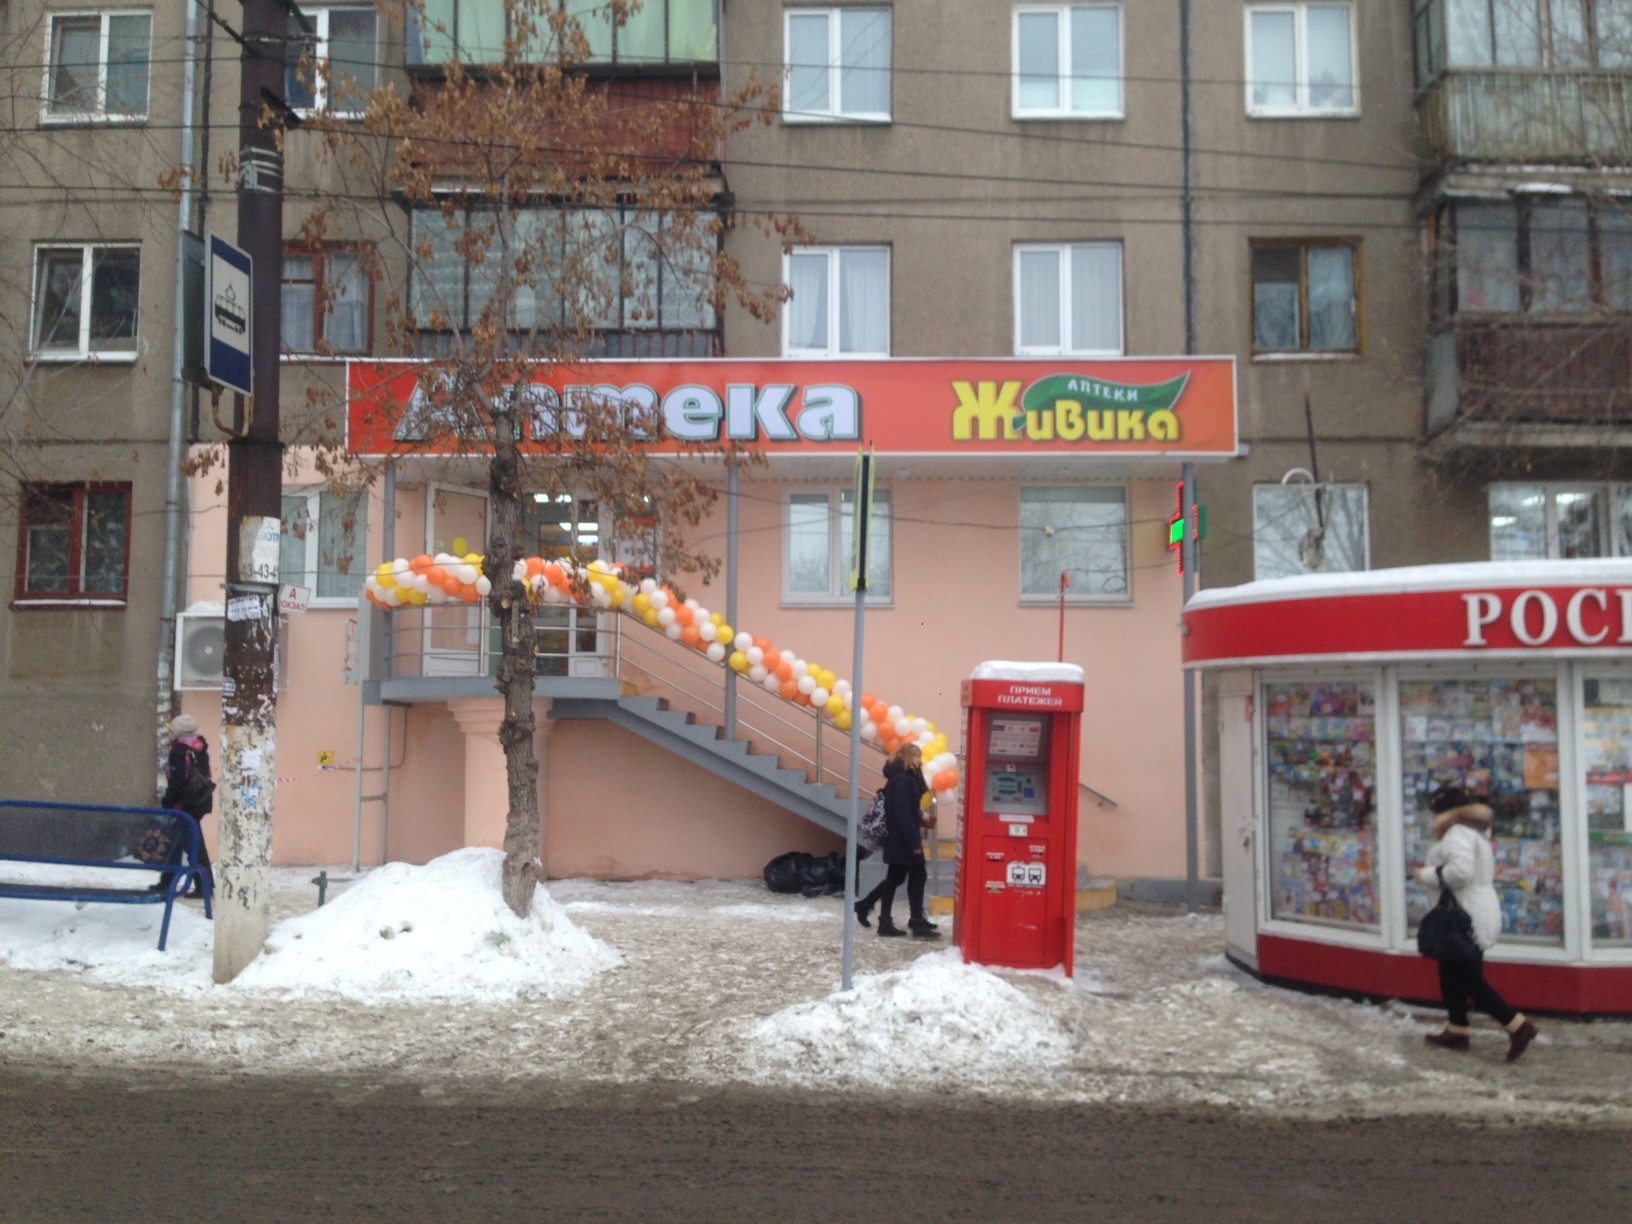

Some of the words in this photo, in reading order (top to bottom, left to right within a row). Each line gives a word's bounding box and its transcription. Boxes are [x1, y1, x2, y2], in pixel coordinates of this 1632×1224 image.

[1067, 378, 1138, 402] АПТЕКИ
[392, 373, 862, 442] Аптека
[952, 380, 1180, 442] Живика
[280, 599, 305, 611] ОКЗАЛ
[1010, 685, 1052, 696] ПРИЕМ
[997, 694, 1063, 707] ПЛАТЕЖЕЙ
